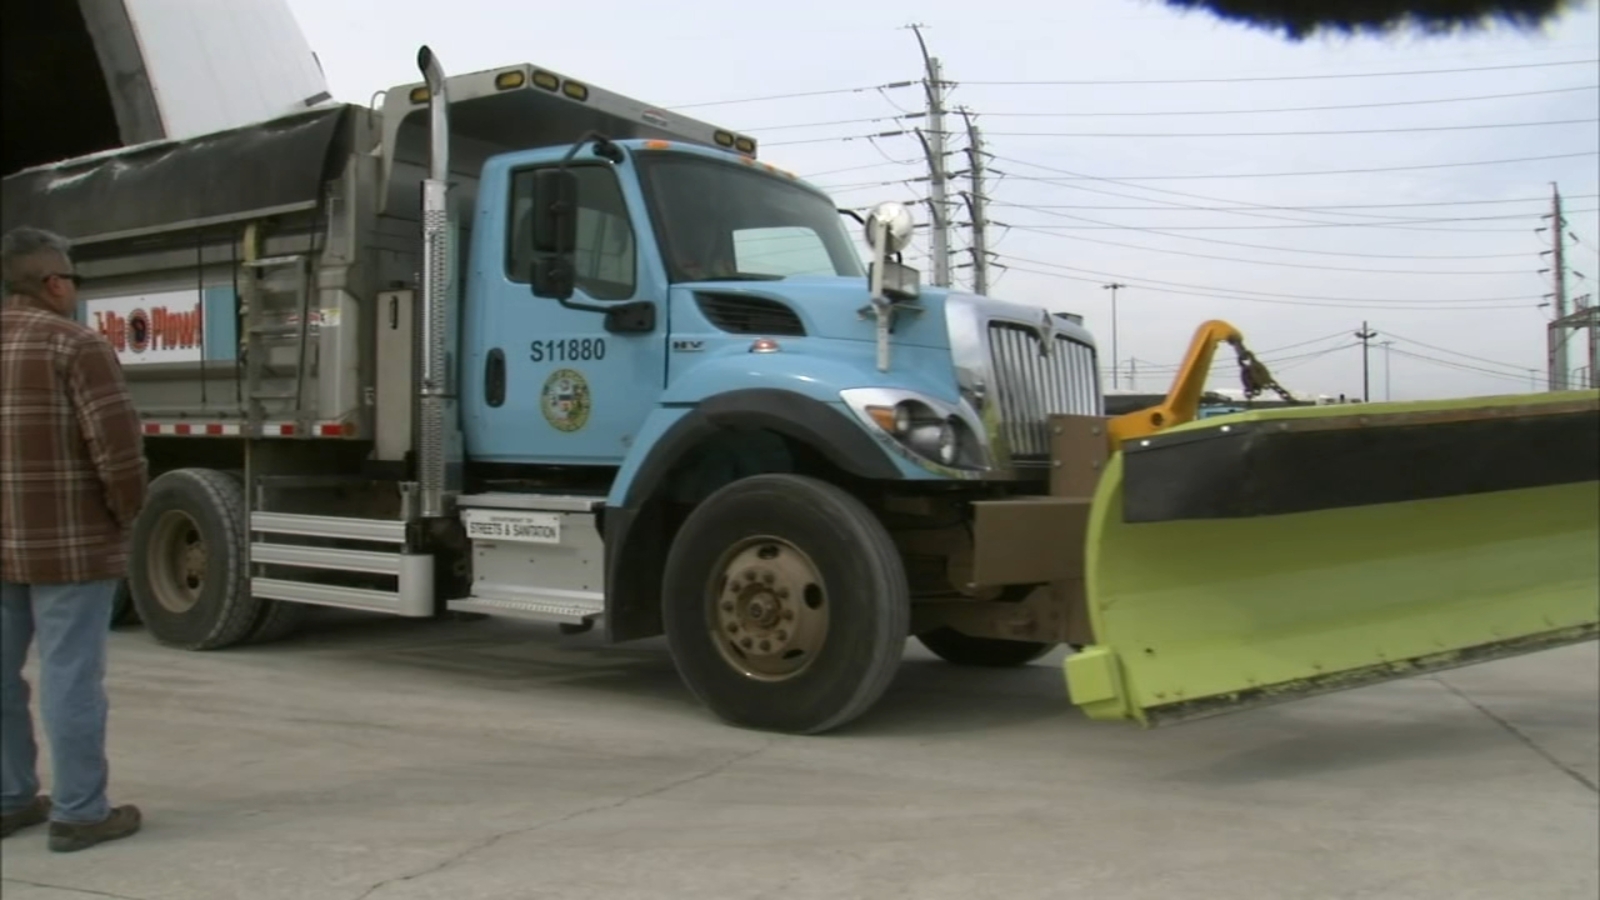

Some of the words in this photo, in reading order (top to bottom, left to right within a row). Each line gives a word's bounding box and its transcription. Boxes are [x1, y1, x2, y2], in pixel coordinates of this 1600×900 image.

[529, 338, 606, 362] S11880
[469, 521, 502, 536] STREETS
[513, 523, 557, 539] SANITATION
